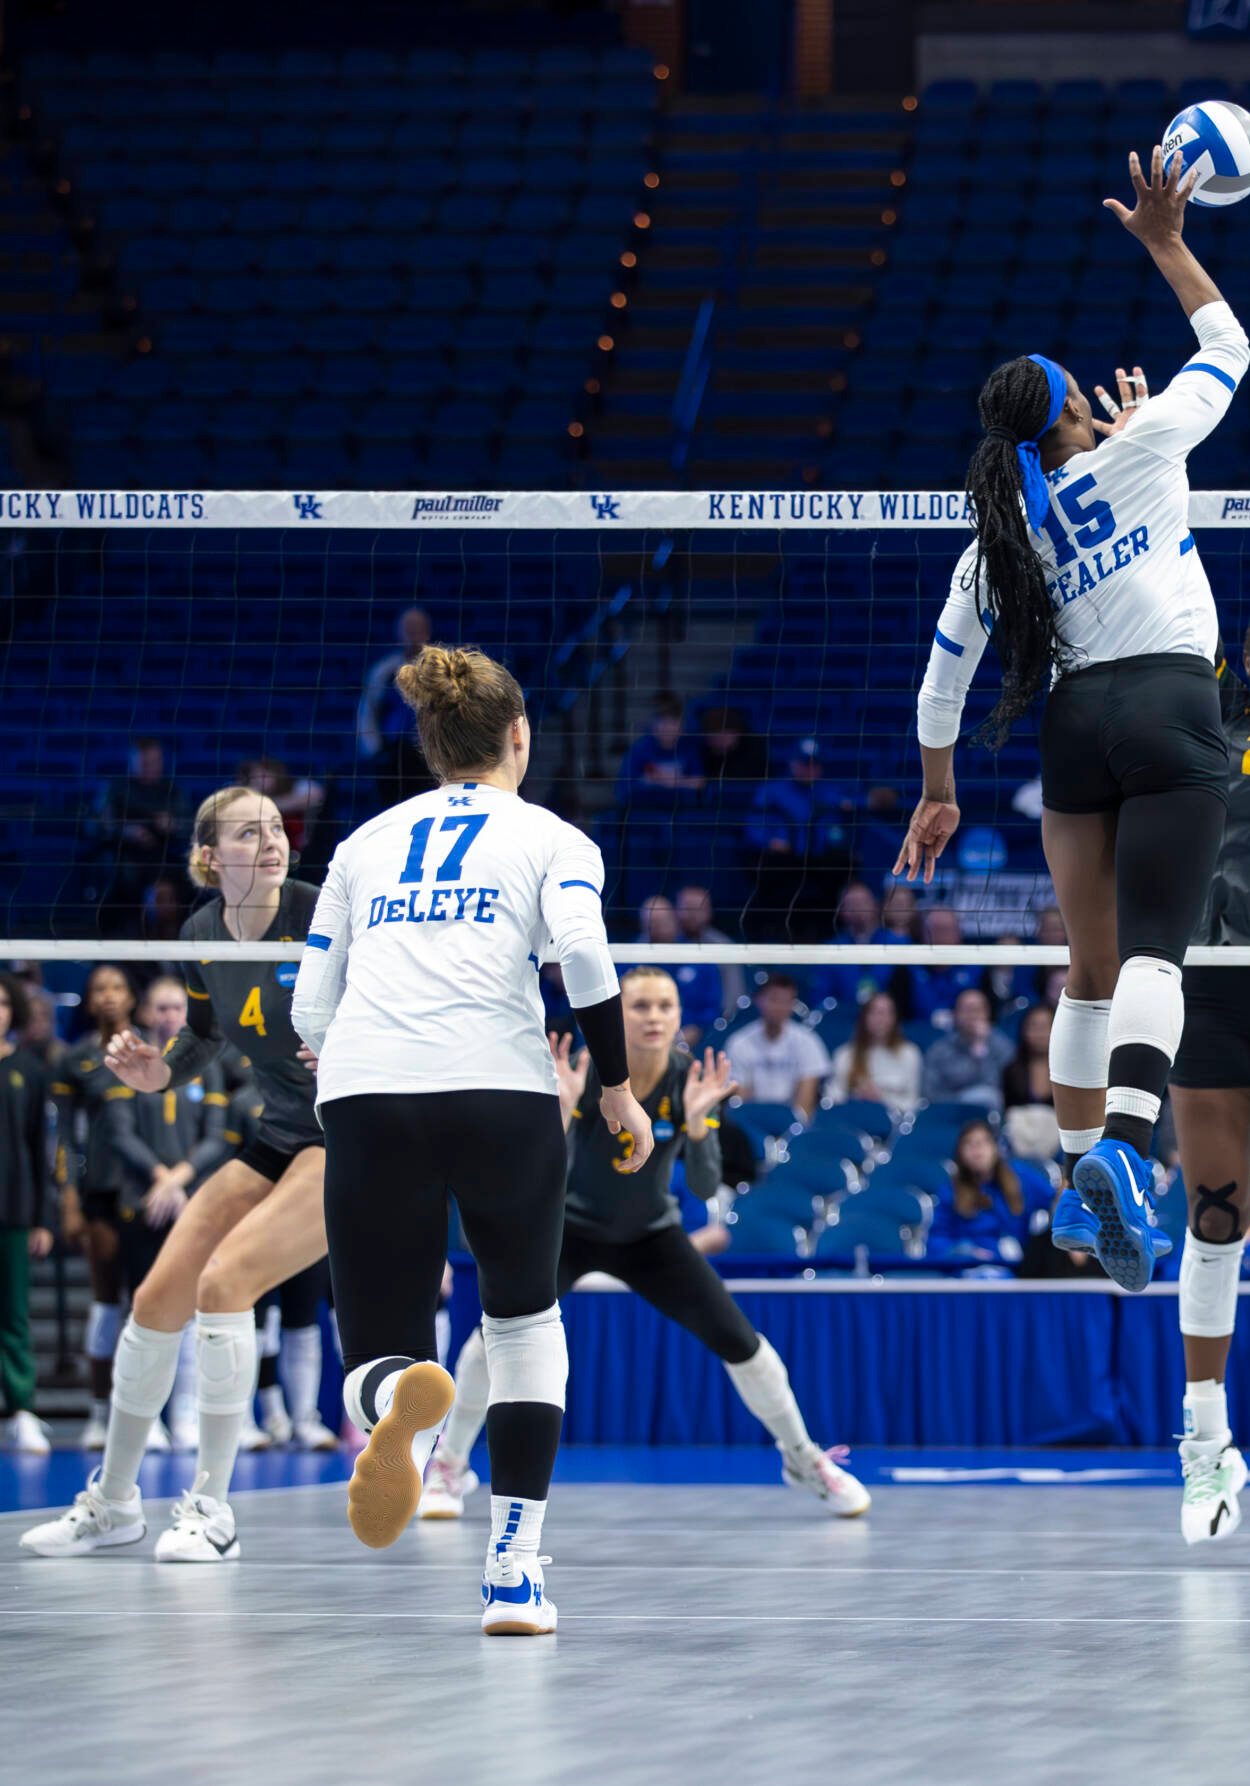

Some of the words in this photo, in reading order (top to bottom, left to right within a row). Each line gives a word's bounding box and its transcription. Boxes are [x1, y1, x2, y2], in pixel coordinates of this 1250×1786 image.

[0, 493, 61, 519] CKY
[76, 494, 203, 519] WILDCATS
[293, 495, 322, 519] UK
[590, 495, 620, 519] UK
[709, 494, 863, 519] KENTUCKY
[1042, 472, 1116, 568] 15
[447, 796, 475, 807] UK
[399, 813, 490, 884] 17
[239, 986, 267, 1036] 4
